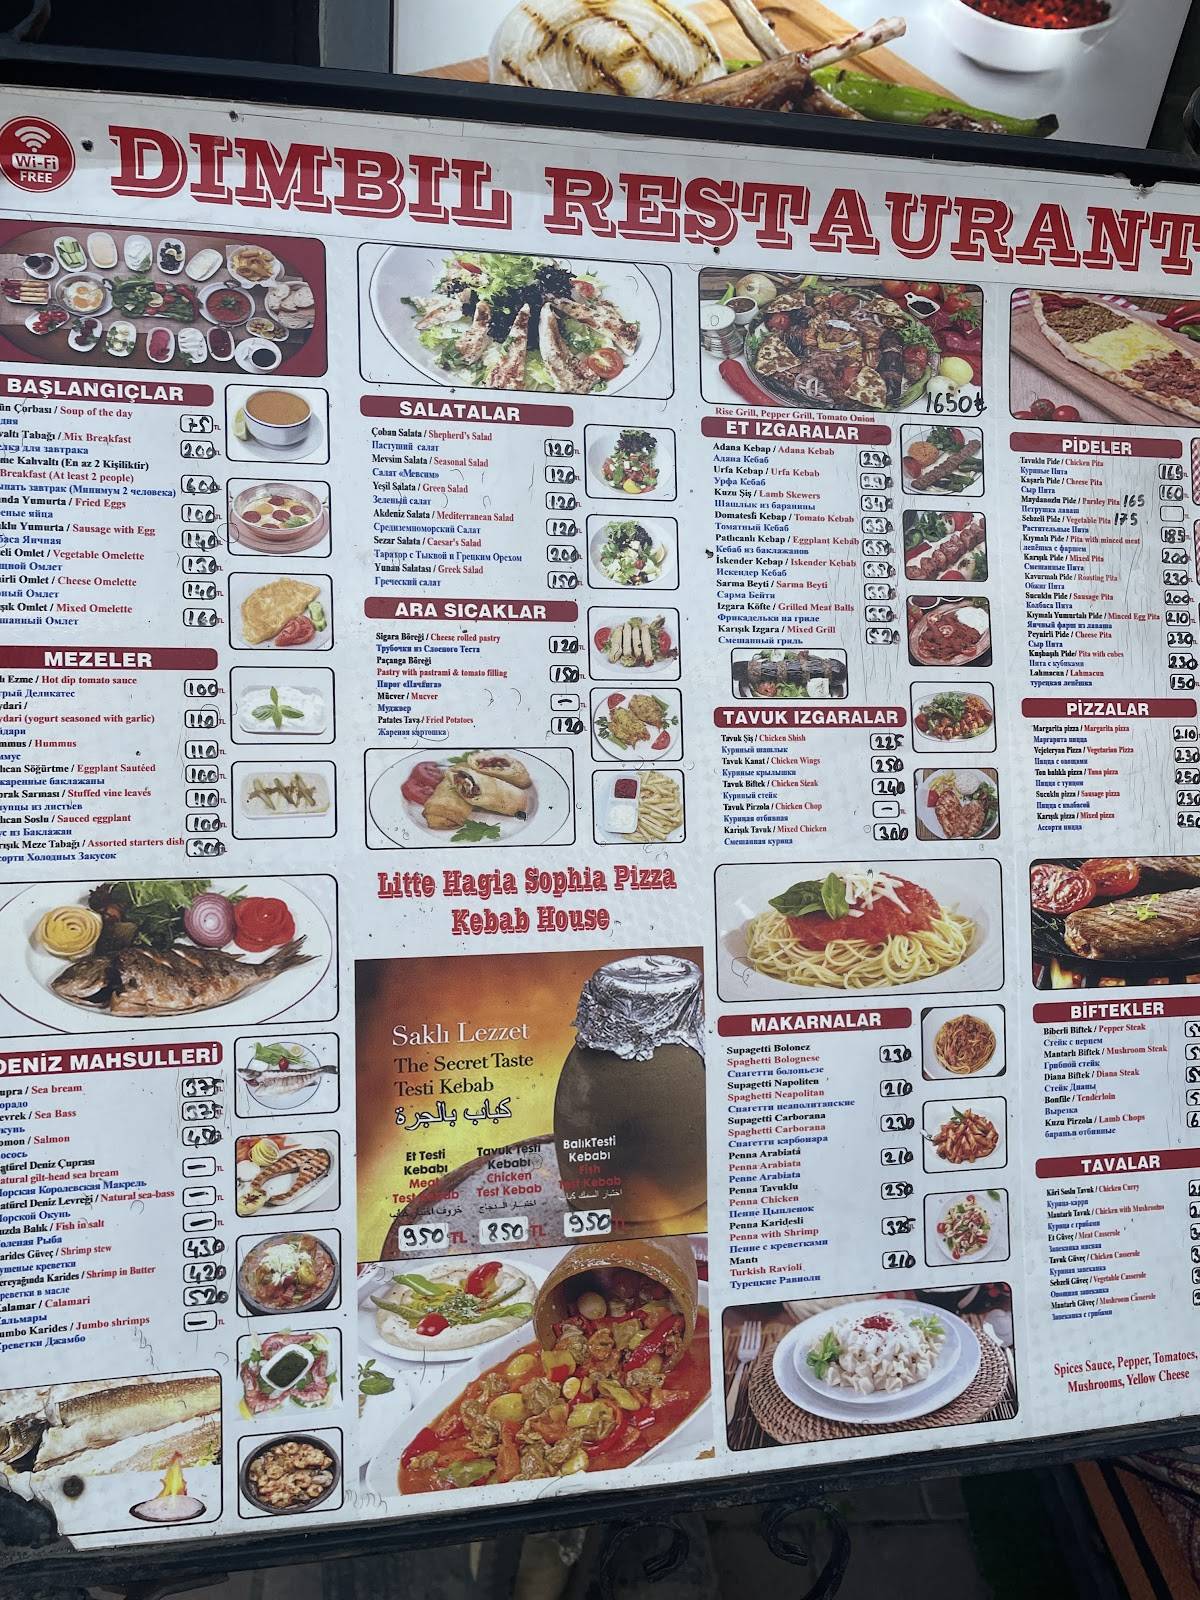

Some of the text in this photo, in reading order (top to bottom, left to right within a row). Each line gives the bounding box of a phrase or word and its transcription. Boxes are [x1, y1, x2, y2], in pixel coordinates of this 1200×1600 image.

[14, 154, 57, 170] Wi-Fi
[20, 171, 52, 184] FREE
[109, 125, 1200, 277] DIMBIL RESTAURANT
[7, 378, 184, 401] BAŞLANGIÇLAR
[60, 406, 84, 417] Soup
[86, 408, 97, 416] of
[98, 408, 114, 417] the
[116, 409, 133, 420] day
[400, 401, 520, 422] SALATALAR
[716, 407, 875, 423] Rise Grill, Pepper Grill, Tomato Onion
[64, 432, 82, 441] Mix
[86, 433, 131, 445] Breakfast
[726, 422, 859, 440] ET IZGARALAR
[713, 442, 835, 456] Adana Kebap Adana Kebab
[1062, 436, 1132, 455] PİDELER
[18, 456, 59, 466] Kahvaltı
[61, 458, 78, 468] (En
[94, 459, 100, 468] 2
[0, 468, 134, 484] Breakfast (At least 2 people)
[759, 490, 821, 500] Lamb Skewers
[22, 496, 126, 510] Yumurta Fried Eggs
[18, 574, 137, 587] Omlet Cheese Omelette
[395, 602, 546, 619] ARA SICAKLAR
[44, 651, 152, 669] MEZELER
[8, 675, 34, 684] Ezme
[42, 675, 58, 684] Hot
[61, 675, 76, 686] dip
[78, 676, 110, 684] tomato
[1066, 699, 1149, 716] PİZZALAR
[723, 710, 899, 725] TAVUK IZGARALAR
[35, 739, 77, 748] Hummus
[759, 734, 806, 742] Chicken Shish
[87, 838, 127, 847] Assorted
[166, 837, 185, 846] dish
[377, 864, 677, 900] Litte Hagia Sophia Pizza
[451, 905, 610, 935] Kebab House
[1071, 1002, 1164, 1019] BİFTEKLER
[751, 1012, 881, 1032] MAKARNALAR
[392, 1022, 530, 1046] Saklı Lezzet
[70, 1044, 218, 1072] MAHSULLERİ
[393, 1052, 534, 1074] The Secret Taste
[727, 1055, 820, 1068] Spaghetti Bolognese
[31, 1085, 82, 1094] Sea bream
[439, 1076, 494, 1094] Kebab
[396, 1096, 512, 1131] كباب بالجرة
[34, 1135, 70, 1144] Salmon
[488, 1159, 531, 1169] Kebabı
[569, 1152, 611, 1162] Kebabı
[1081, 1155, 1160, 1173] TAVALAR
[404, 1164, 447, 1175] Kebabı
[486, 1171, 532, 1184] Chicken
[476, 1184, 542, 1198] Test Kebab
[730, 1263, 802, 1277] Turkish Ravioli
[44, 1296, 90, 1308] Calamari
[1054, 1351, 1198, 1378] Spices Sauce, Pepper, Tomatoes,
[1068, 1369, 1190, 1393] Mushrooms, Yellow Cheese
